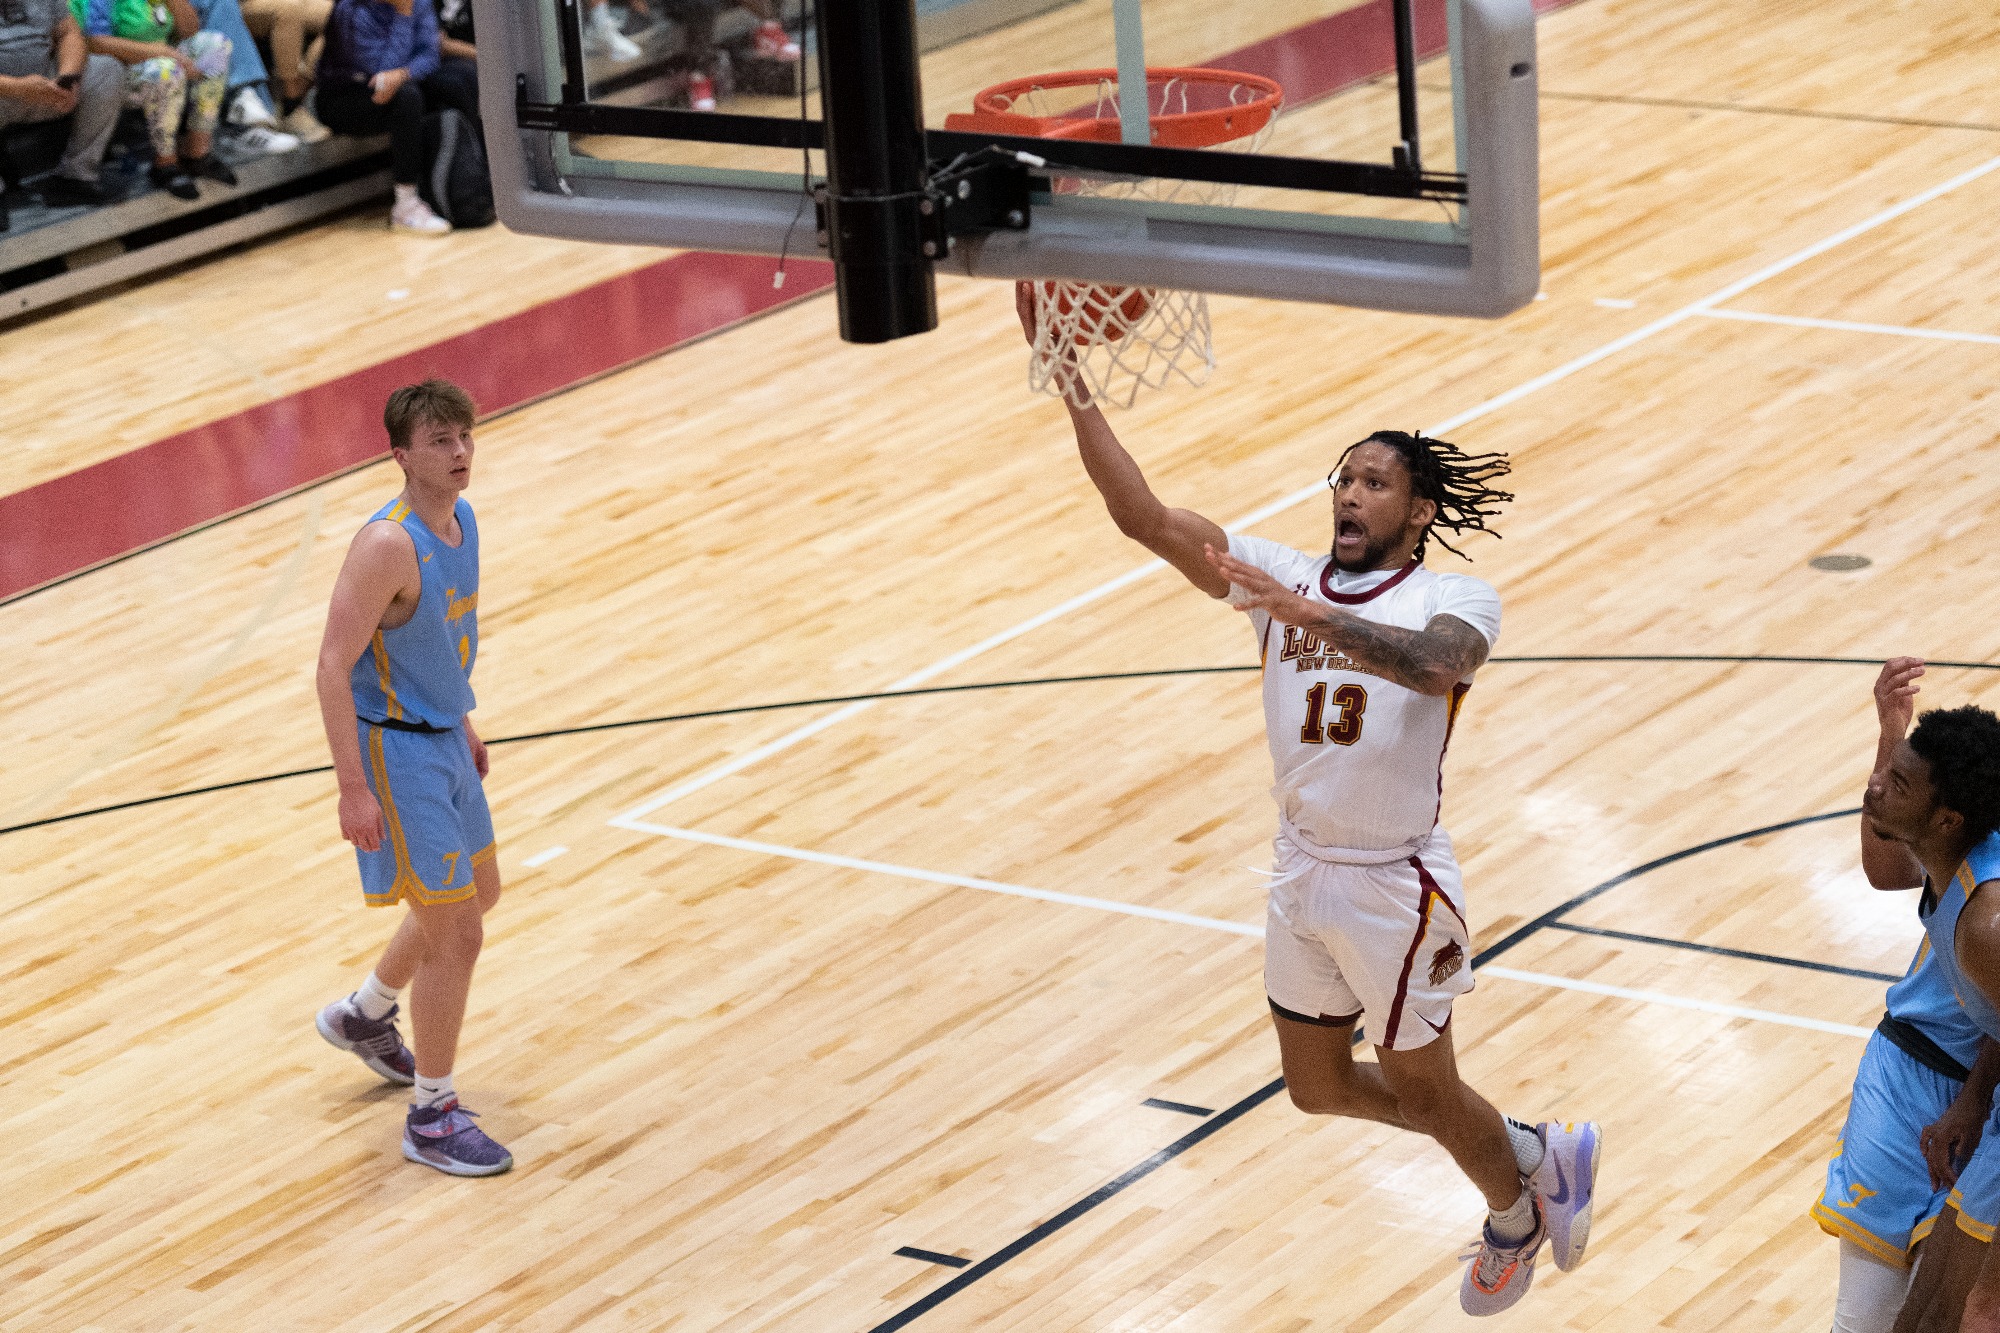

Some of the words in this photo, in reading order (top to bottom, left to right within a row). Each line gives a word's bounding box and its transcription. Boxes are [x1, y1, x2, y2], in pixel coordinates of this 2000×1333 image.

[1296, 656, 1326, 672] NEW
[1327, 656, 1374, 675] ORLE
[1300, 681, 1368, 747] 13
